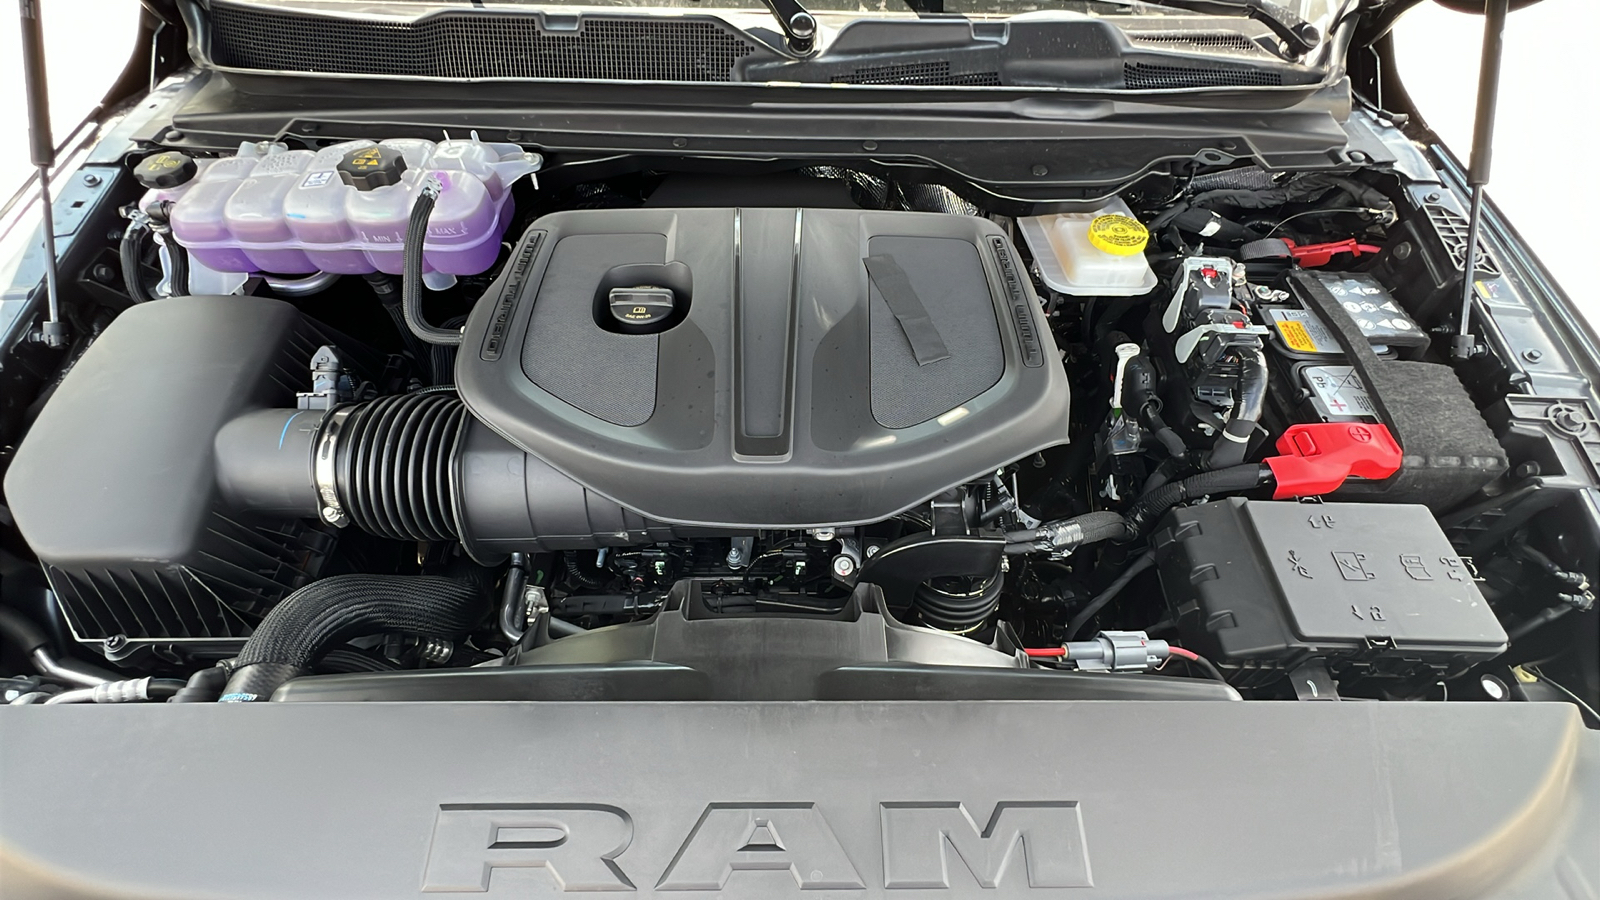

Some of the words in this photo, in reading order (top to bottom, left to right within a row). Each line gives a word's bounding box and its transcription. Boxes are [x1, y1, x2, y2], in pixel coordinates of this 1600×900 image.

[373, 235, 391, 243] MIN
[434, 227, 457, 235] MAX
[514, 232, 542, 277] TWIN
[992, 237, 1020, 300] TURBO
[486, 280, 521, 356] TURBO
[1014, 304, 1038, 361] TWIN
[1312, 376, 1327, 389] Pb
[422, 800, 1095, 893] RAM
